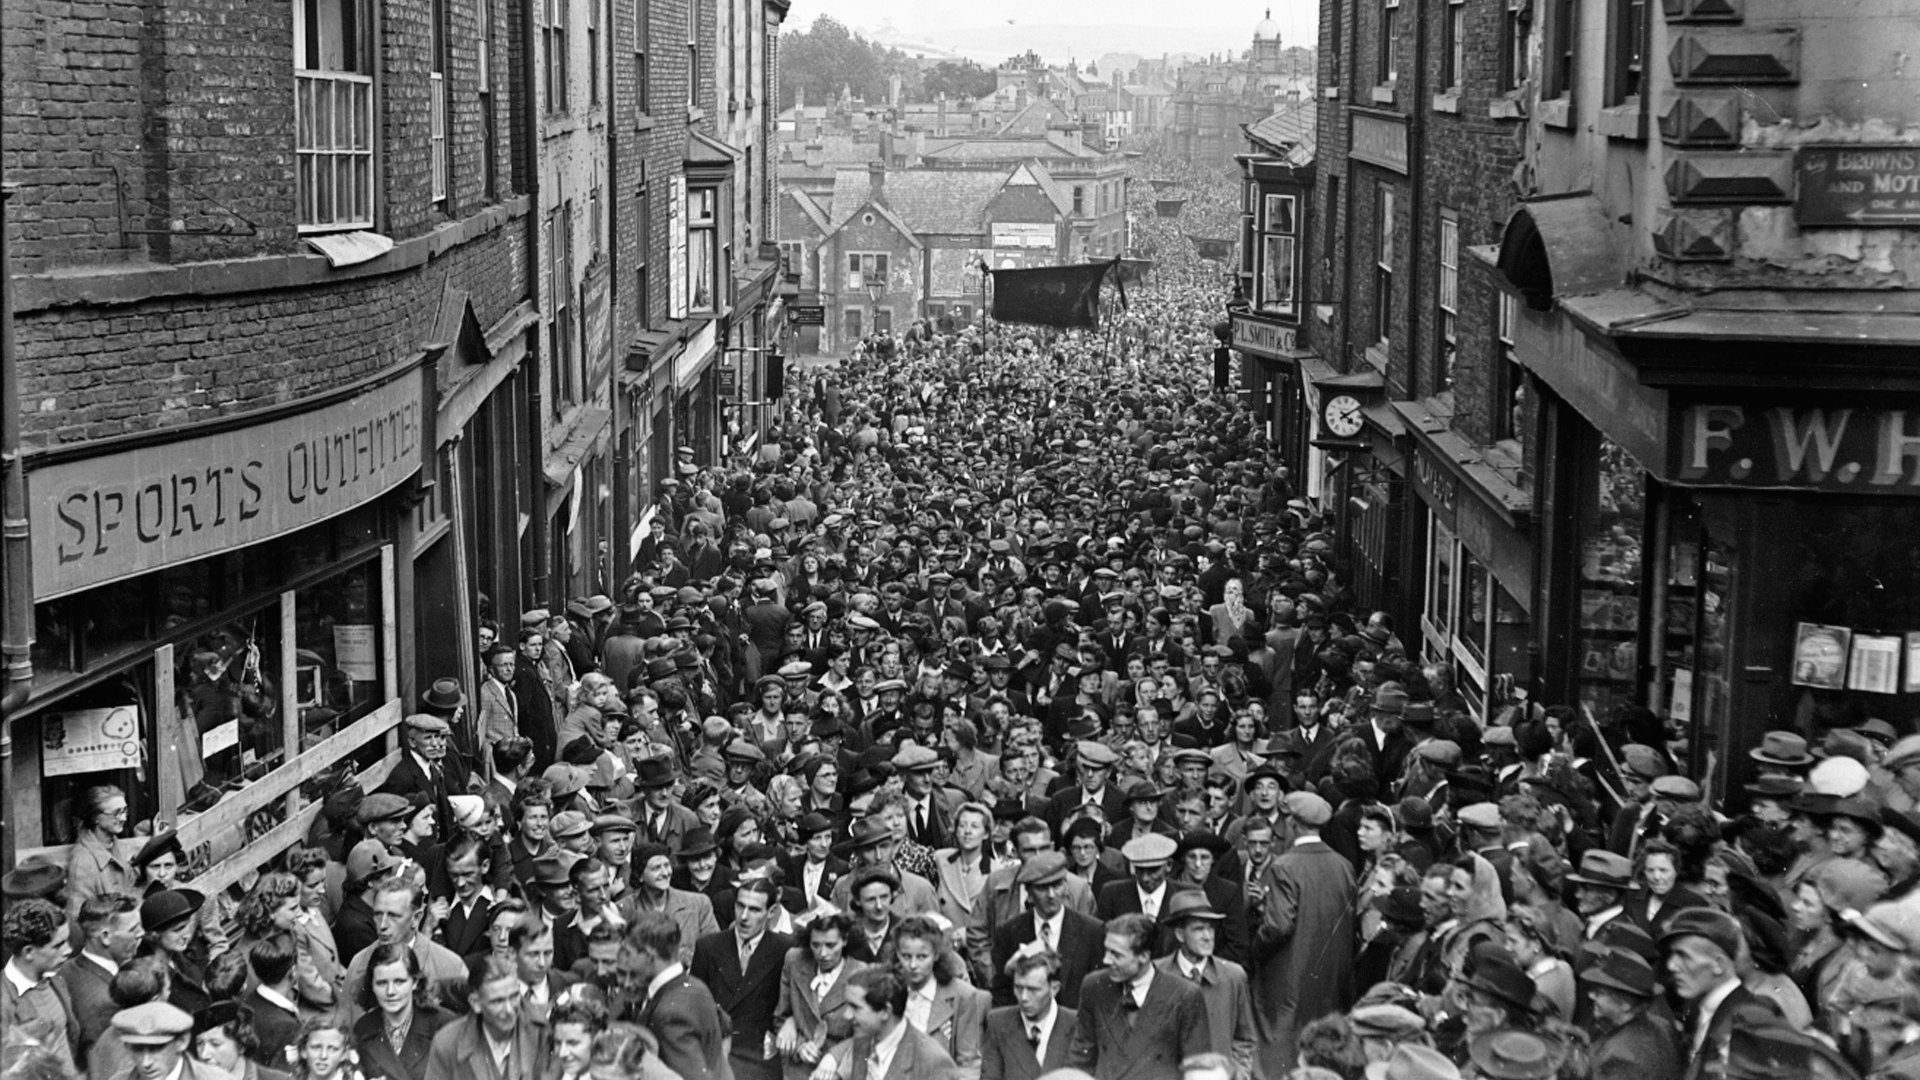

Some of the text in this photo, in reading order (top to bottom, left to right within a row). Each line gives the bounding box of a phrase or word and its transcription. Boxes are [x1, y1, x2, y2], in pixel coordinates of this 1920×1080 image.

[1826, 181, 1865, 193] AND
[1872, 199, 1897, 209] ONE
[1276, 336, 1283, 350] &
[57, 460, 263, 567] SPORTS
